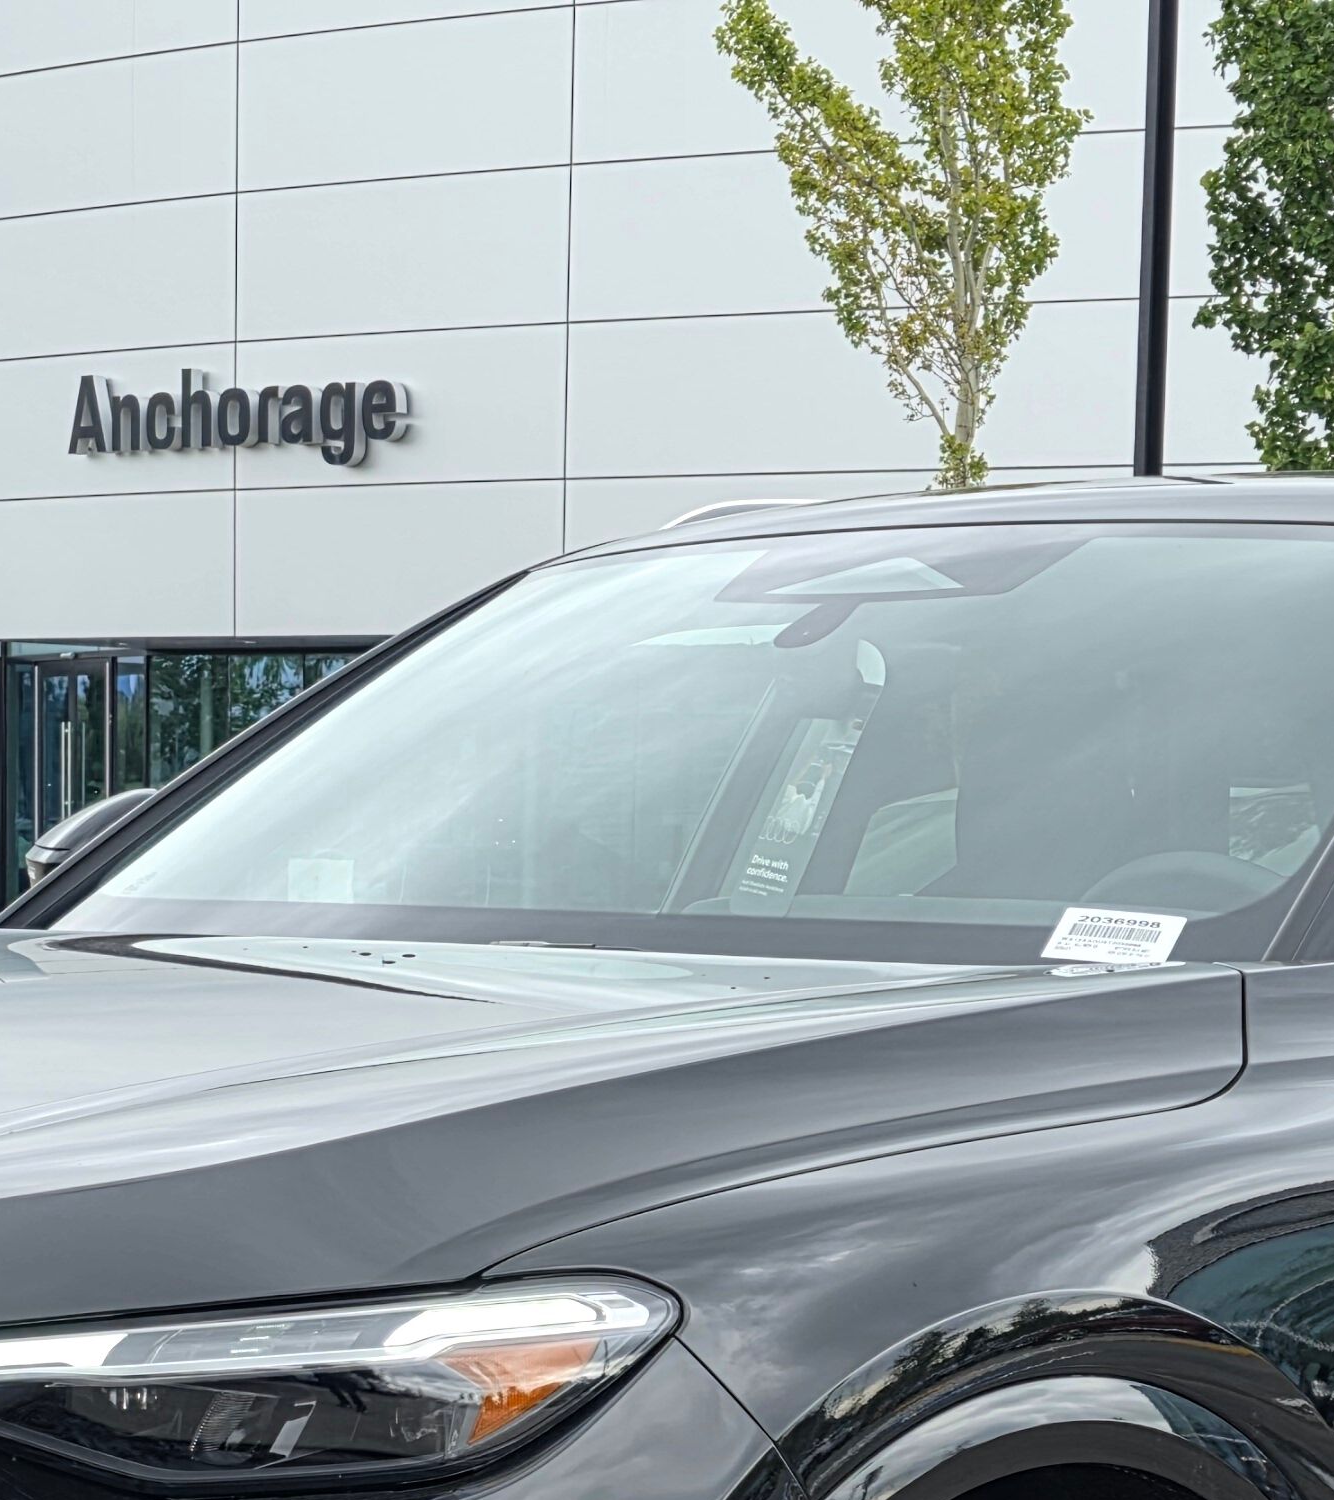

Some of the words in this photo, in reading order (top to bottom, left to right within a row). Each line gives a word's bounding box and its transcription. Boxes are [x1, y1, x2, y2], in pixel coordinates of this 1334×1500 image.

[68, 368, 408, 466] Anchorage
[751, 854, 771, 867] Drive
[771, 859, 789, 871] with
[746, 866, 788, 883] confidence.
[1077, 915, 1161, 929] 2036998
